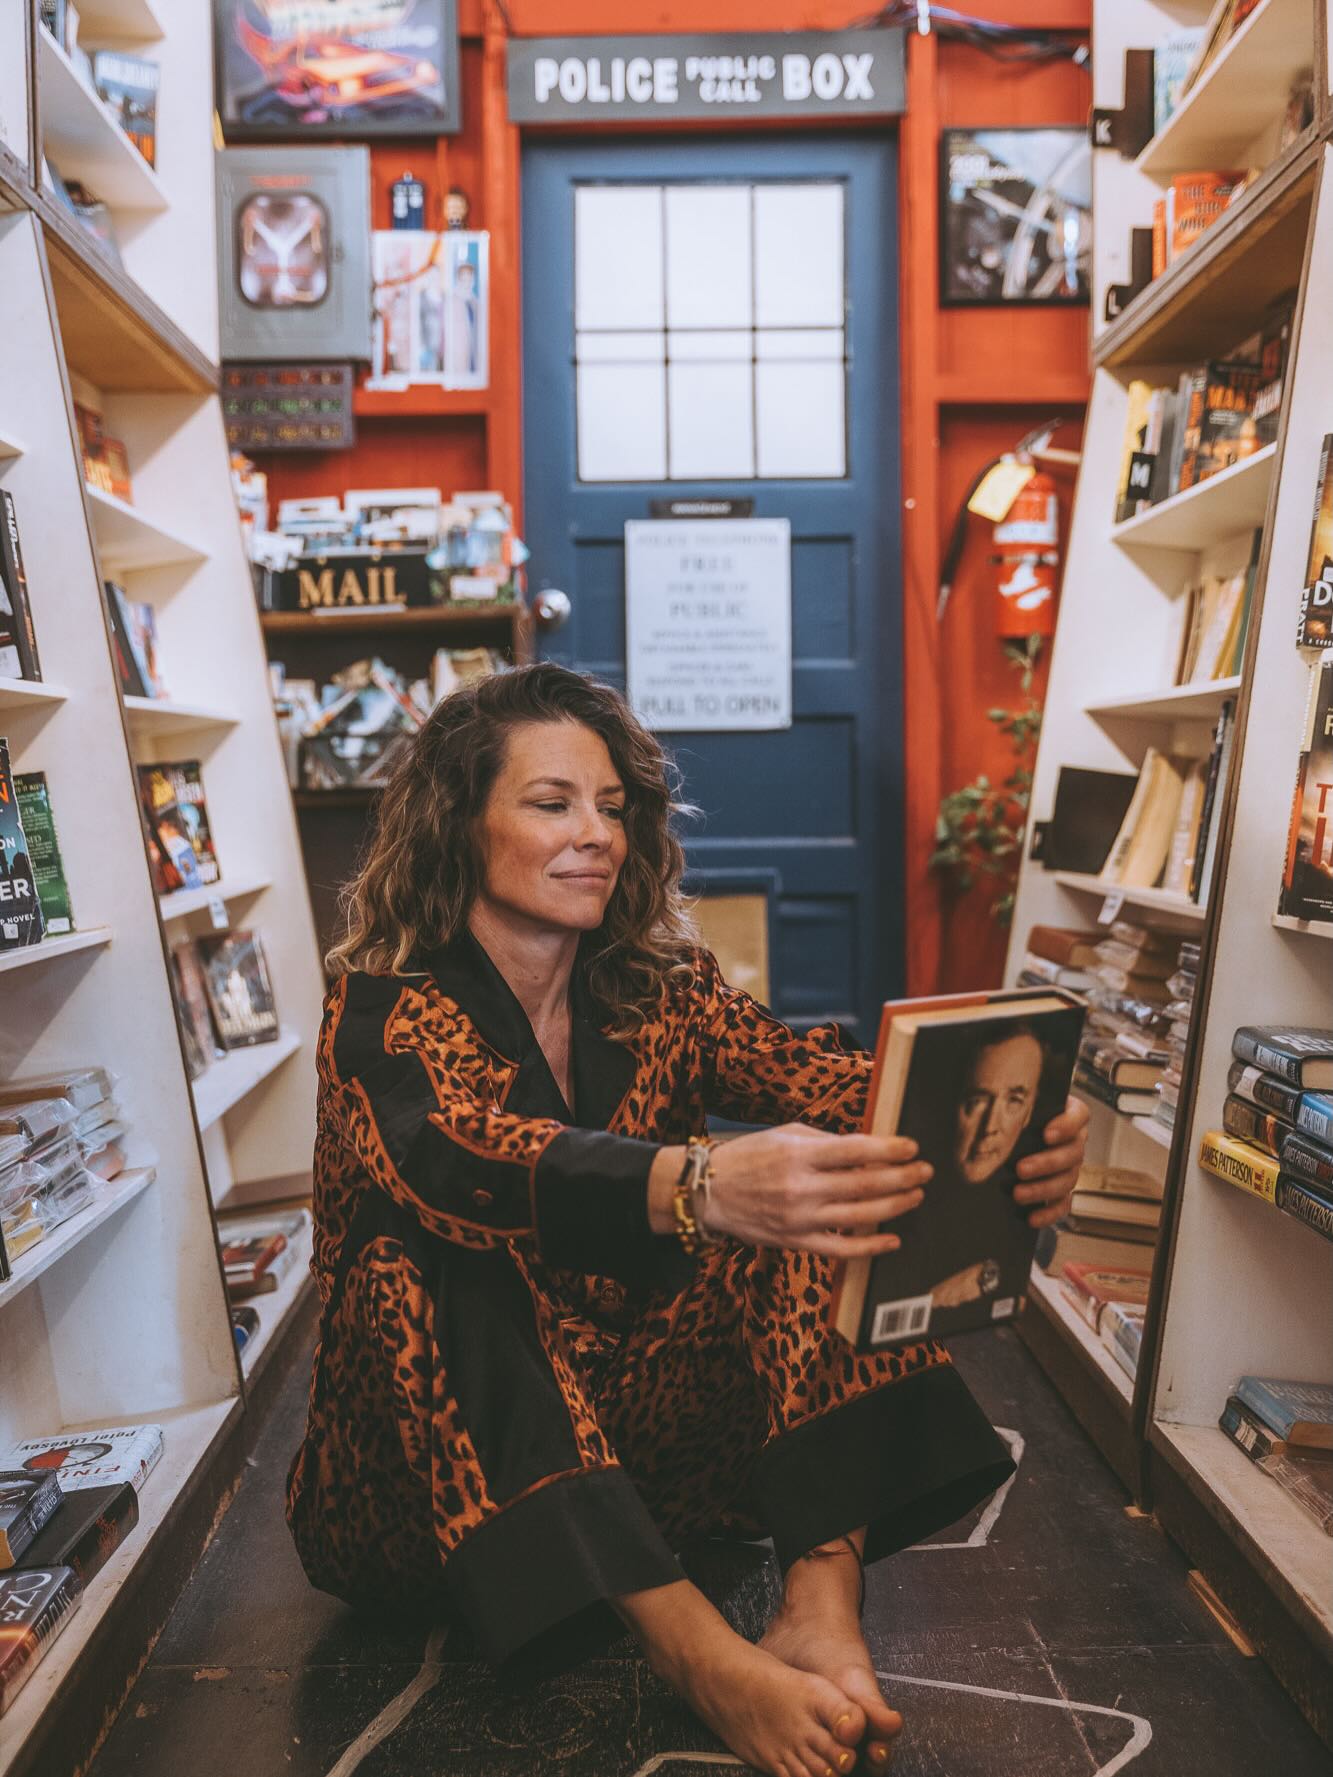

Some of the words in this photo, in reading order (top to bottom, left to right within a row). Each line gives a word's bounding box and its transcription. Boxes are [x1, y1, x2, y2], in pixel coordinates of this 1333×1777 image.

[534, 57, 679, 103] POLICE
[685, 56, 776, 80] PUBLIC
[782, 53, 875, 100] BOX
[699, 80, 762, 102] CALL
[1096, 119, 1112, 144] K
[1131, 462, 1150, 489] M
[298, 566, 407, 607] MAIL
[7, 913, 36, 924] NOVEL
[1199, 1143, 1219, 1168] JAMES
[1218, 1151, 1254, 1186] PATTERSON
[20, 1437, 88, 1451] Lovesey
[91, 1430, 136, 1442] Peter
